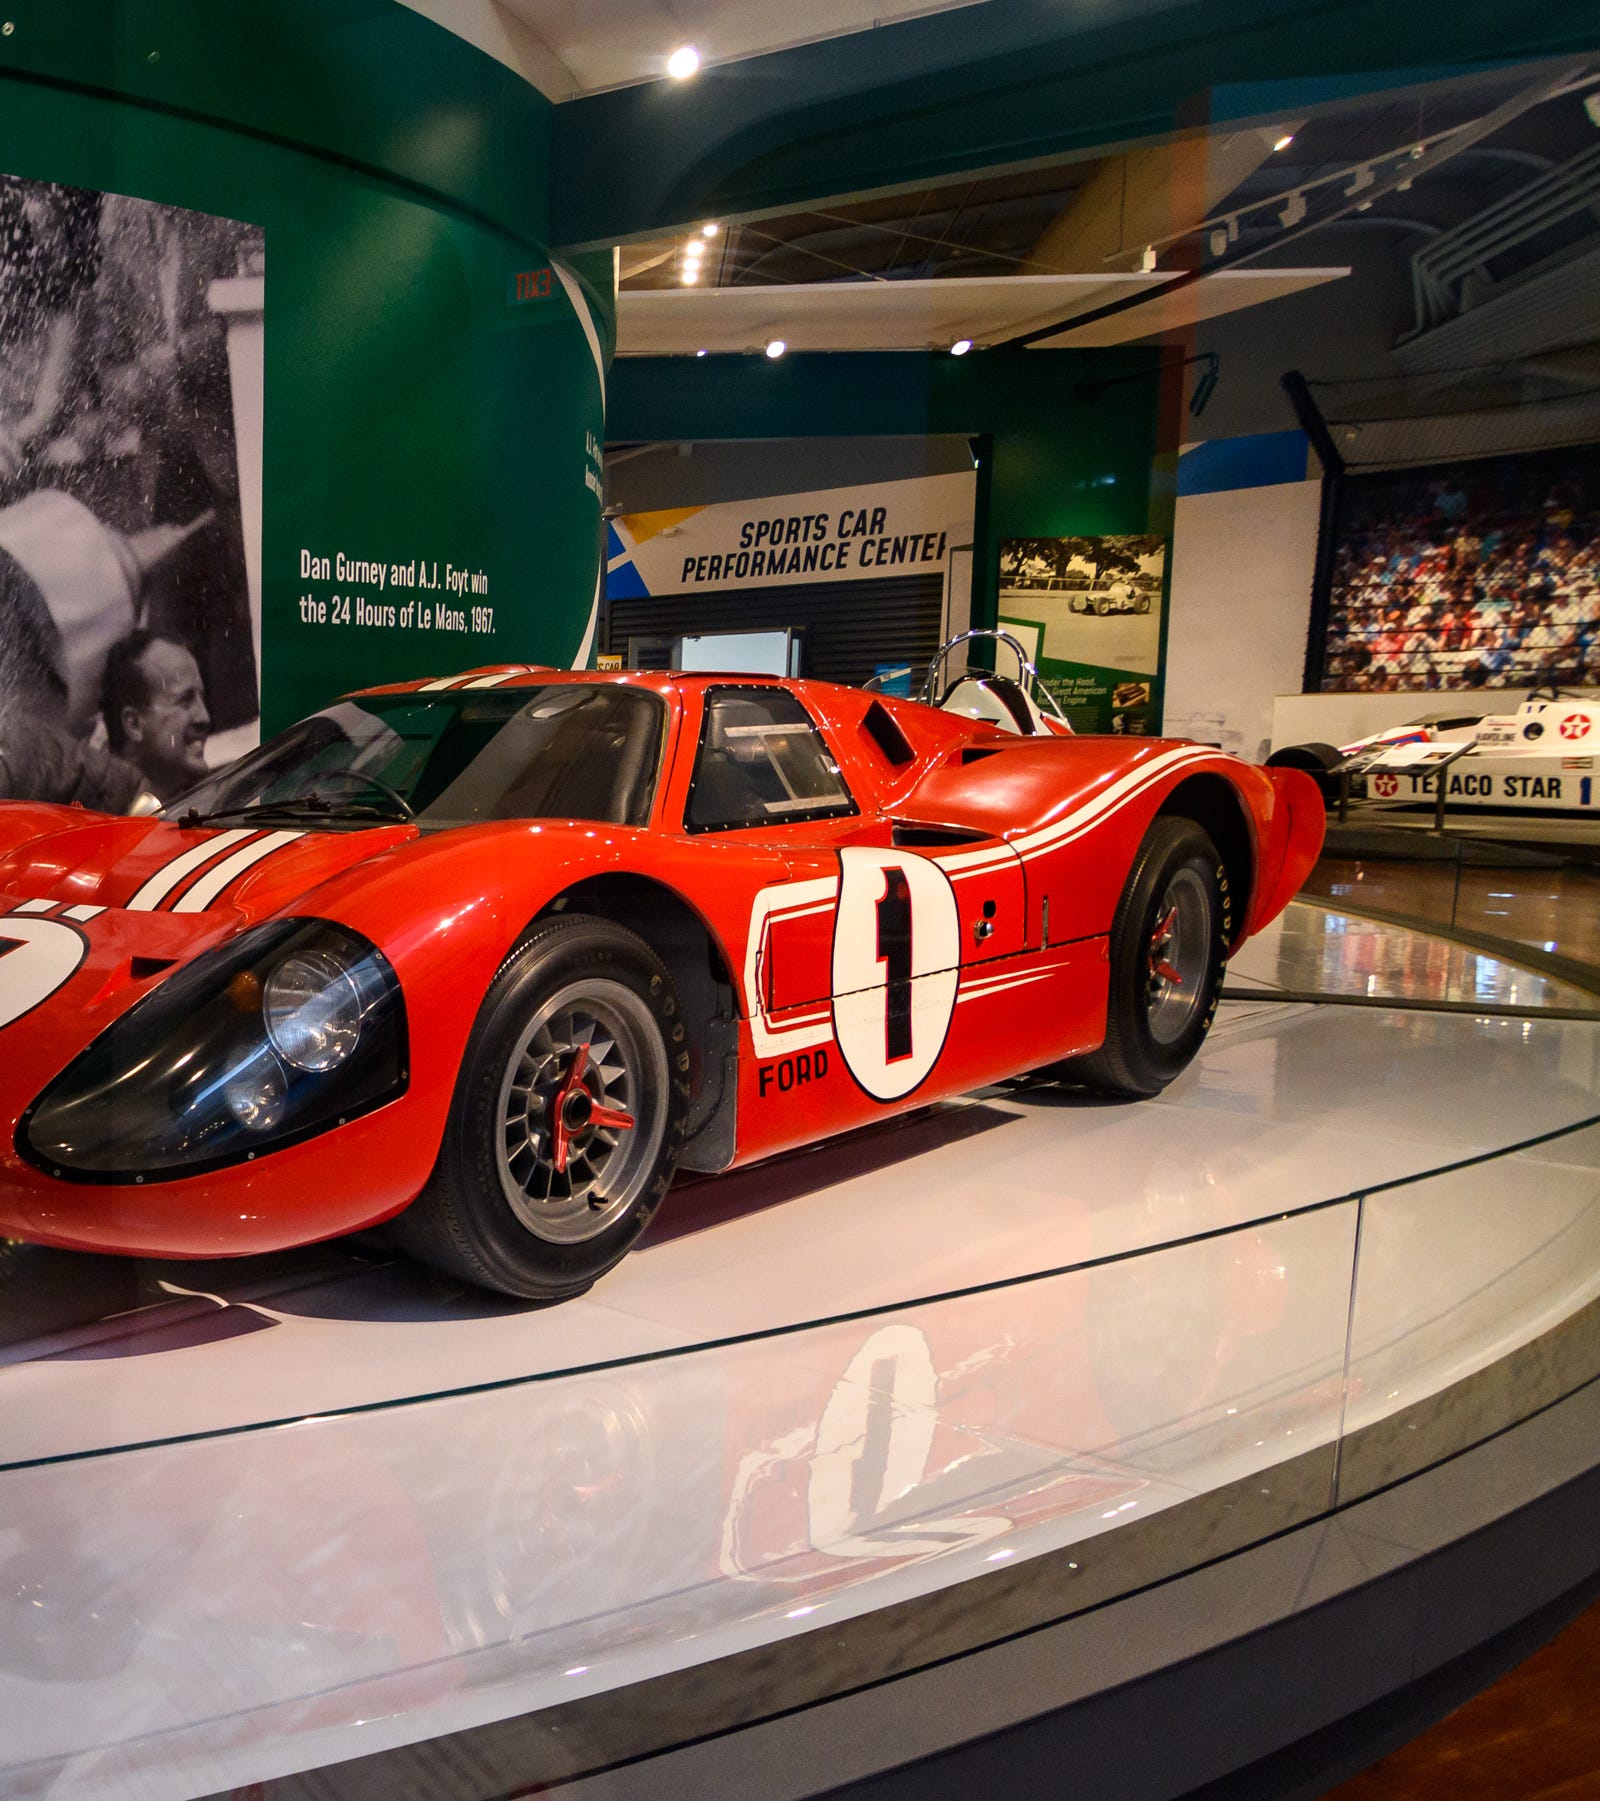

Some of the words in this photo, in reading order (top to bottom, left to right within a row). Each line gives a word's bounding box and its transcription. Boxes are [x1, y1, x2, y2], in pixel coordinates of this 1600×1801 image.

[739, 513, 829, 548] SPORTS
[837, 507, 887, 538] CAR
[300, 549, 331, 580] Dan
[336, 552, 387, 591] Gurney
[390, 560, 415, 587] and
[418, 561, 441, 589] A.J.
[446, 563, 469, 598] Foyt
[471, 569, 488, 595] win
[681, 542, 852, 583] PERFORMANCE
[299, 593, 327, 624] the
[331, 595, 351, 625] 24
[356, 597, 396, 627] Hours
[400, 600, 414, 628] of
[418, 601, 431, 629] Le
[436, 603, 468, 634] Mans,
[471, 606, 496, 634] 1967.
[1410, 774, 1492, 797] TEACO
[1504, 775, 1562, 799] STAR
[1580, 776, 1592, 805] 1
[875, 866, 914, 1066] 1
[758, 1050, 829, 1097] FORD
